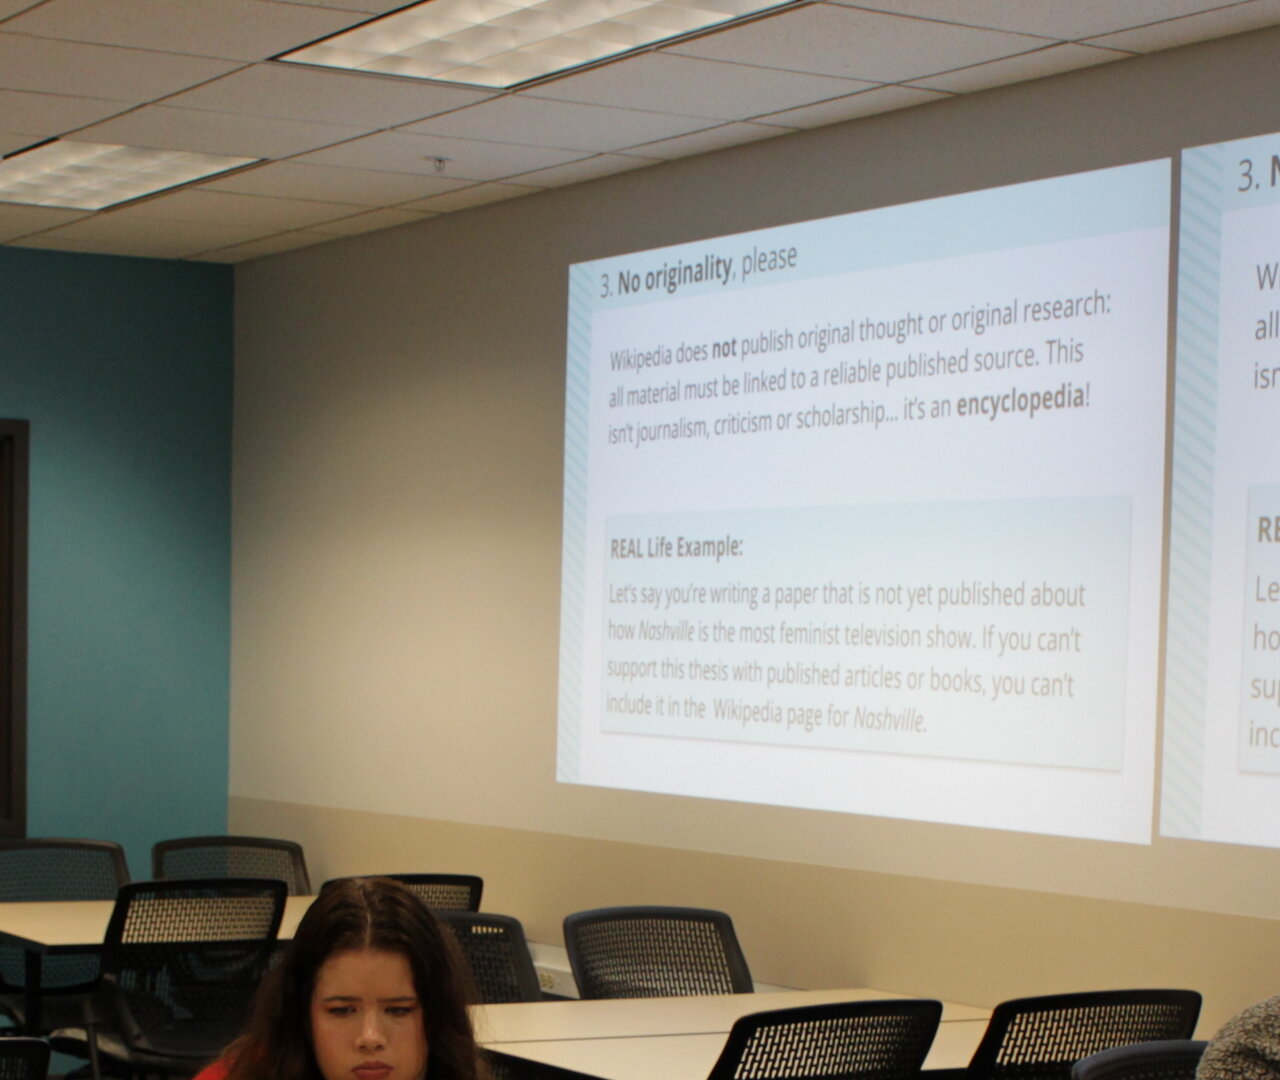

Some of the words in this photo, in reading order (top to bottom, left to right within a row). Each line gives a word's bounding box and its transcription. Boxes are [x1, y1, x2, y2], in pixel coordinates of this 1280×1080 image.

[1239, 159, 1259, 191] 3.
[601, 274, 614, 298] 3.
[618, 270, 641, 294] No
[645, 254, 735, 294] originality,
[743, 247, 797, 281] please
[610, 345, 672, 373] Wikipedia
[676, 342, 708, 364] does
[712, 337, 737, 359] not
[741, 328, 793, 361] publish
[798, 320, 854, 353] original
[859, 312, 923, 344] thought
[928, 314, 947, 333] or
[952, 299, 1017, 336] original
[1024, 289, 1111, 322] research:
[1255, 311, 1279, 340] all
[609, 387, 623, 408] all
[627, 380, 680, 405] material
[684, 379, 718, 399] must
[722, 375, 740, 396] be
[744, 368, 786, 393] linked
[791, 370, 806, 389] to
[810, 370, 819, 387] a
[824, 359, 881, 386] reliable
[886, 348, 969, 387] published
[974, 348, 1039, 372] source.
[1045, 338, 1084, 364] This
[636, 418, 709, 448] journalism,
[714, 415, 772, 435] criticism
[777, 413, 792, 430] or
[931, 399, 951, 418] an
[957, 382, 1090, 421] encyclopedia!
[611, 538, 643, 558] REAL
[648, 536, 673, 558] Life
[677, 535, 743, 562] Example:
[641, 587, 662, 610] say
[710, 585, 758, 611] writing
[762, 587, 770, 604] a
[775, 587, 819, 610] paper
[823, 581, 854, 604] that
[859, 587, 870, 604] is
[876, 584, 902, 605] not
[907, 584, 933, 612] yet
[938, 581, 1025, 612] published
[1031, 581, 1086, 607] about
[608, 619, 635, 640] how
[639, 620, 695, 642] Nashville
[699, 625, 709, 642] is
[713, 620, 736, 643] the
[740, 624, 776, 644] most
[780, 621, 840, 645] feminist
[845, 623, 921, 647] television
[926, 624, 976, 649] show.
[983, 624, 995, 649] If
[998, 632, 1031, 657] you
